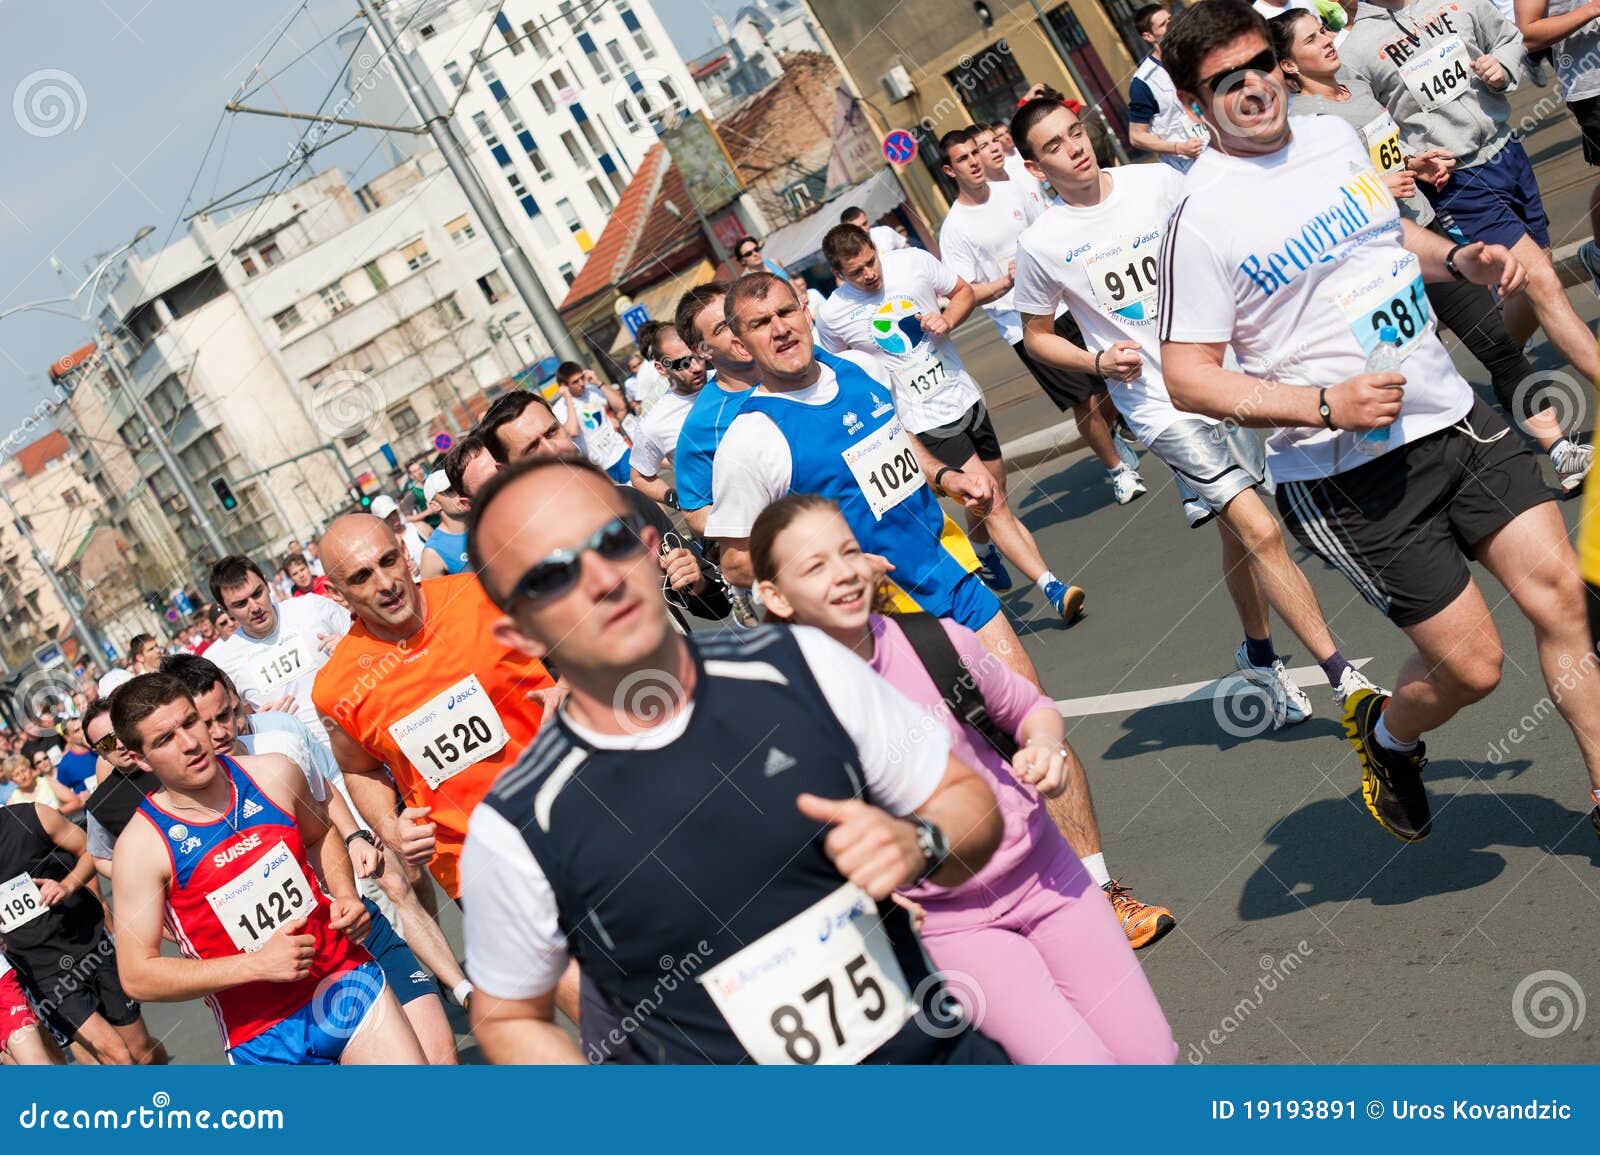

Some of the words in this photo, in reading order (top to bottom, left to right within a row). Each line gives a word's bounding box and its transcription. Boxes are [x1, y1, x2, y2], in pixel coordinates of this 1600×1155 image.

[1420, 60, 1467, 102] 1464
[1240, 186, 1369, 297] Beograd
[1104, 256, 1157, 301] 910
[910, 360, 947, 395] 1377
[869, 448, 919, 498] 1020
[260, 648, 300, 683] 1157
[422, 715, 492, 770] 1520
[213, 833, 262, 868] SUISSE
[238, 877, 303, 941] 1425
[770, 954, 886, 1065] 875
